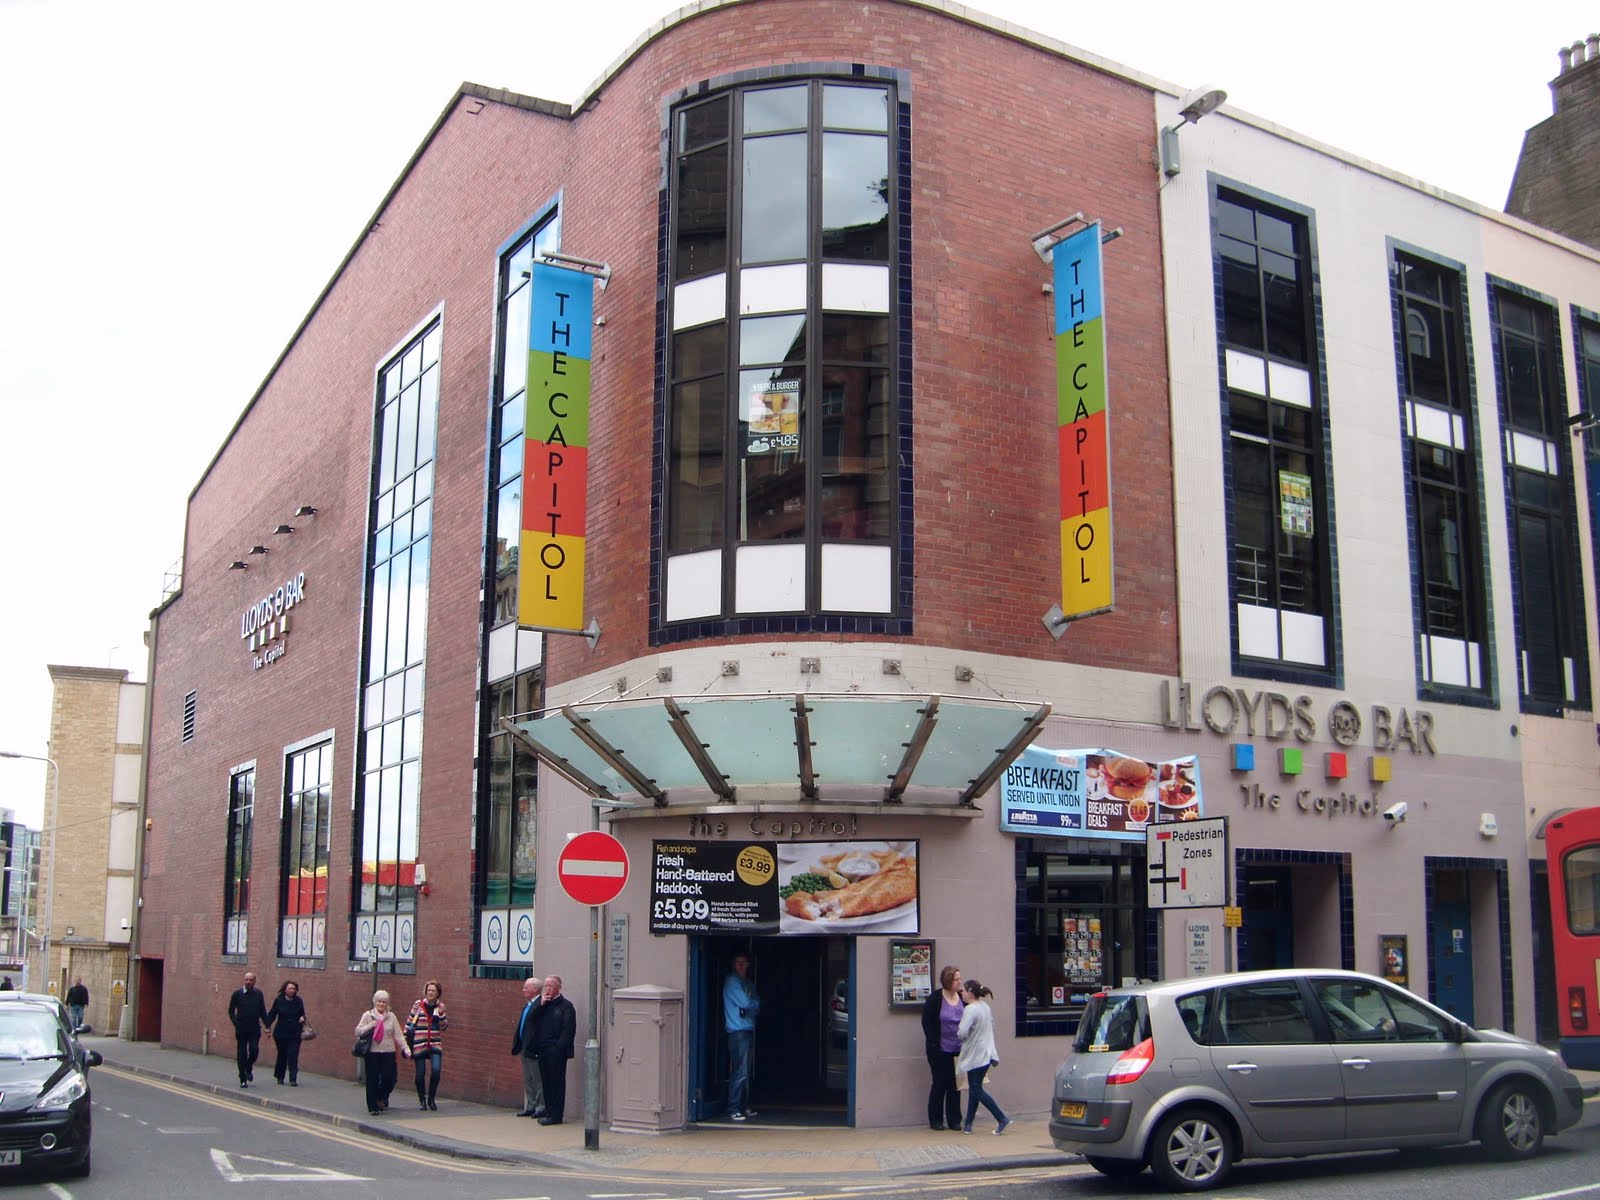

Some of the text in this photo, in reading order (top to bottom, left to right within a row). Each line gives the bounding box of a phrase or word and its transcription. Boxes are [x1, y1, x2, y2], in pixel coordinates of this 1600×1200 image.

[777, 381, 799, 390] BURGER
[1070, 260, 1095, 584] THE CAPITOL
[540, 292, 571, 601] THE CAPITOL
[770, 435, 799, 447] £4.85
[241, 572, 304, 639] LLOYDS BAR
[264, 640, 285, 664] Capitol
[1160, 680, 1316, 742] LLOYDS
[1371, 704, 1437, 755] BAR
[1007, 766, 1080, 792] BREAKFAST
[1007, 790, 1081, 807] SERVED UNTIL NOON
[1240, 783, 1381, 819] The Capitol
[1087, 801, 1123, 816] BREAKFAST
[1130, 804, 1149, 816] £1.49
[688, 816, 857, 838] The Capitol
[1087, 815, 1108, 828] DEALS
[1172, 828, 1224, 842] Pedestrian
[656, 844, 697, 854] Fish and chips
[1183, 847, 1212, 859] Zones
[656, 854, 684, 866] Fresh
[740, 858, 771, 874] £3.99
[656, 868, 735, 882] Hand-Battered
[655, 882, 703, 895] Haddock
[654, 898, 709, 920] £5.99
[518, 927, 531, 940] No.1
